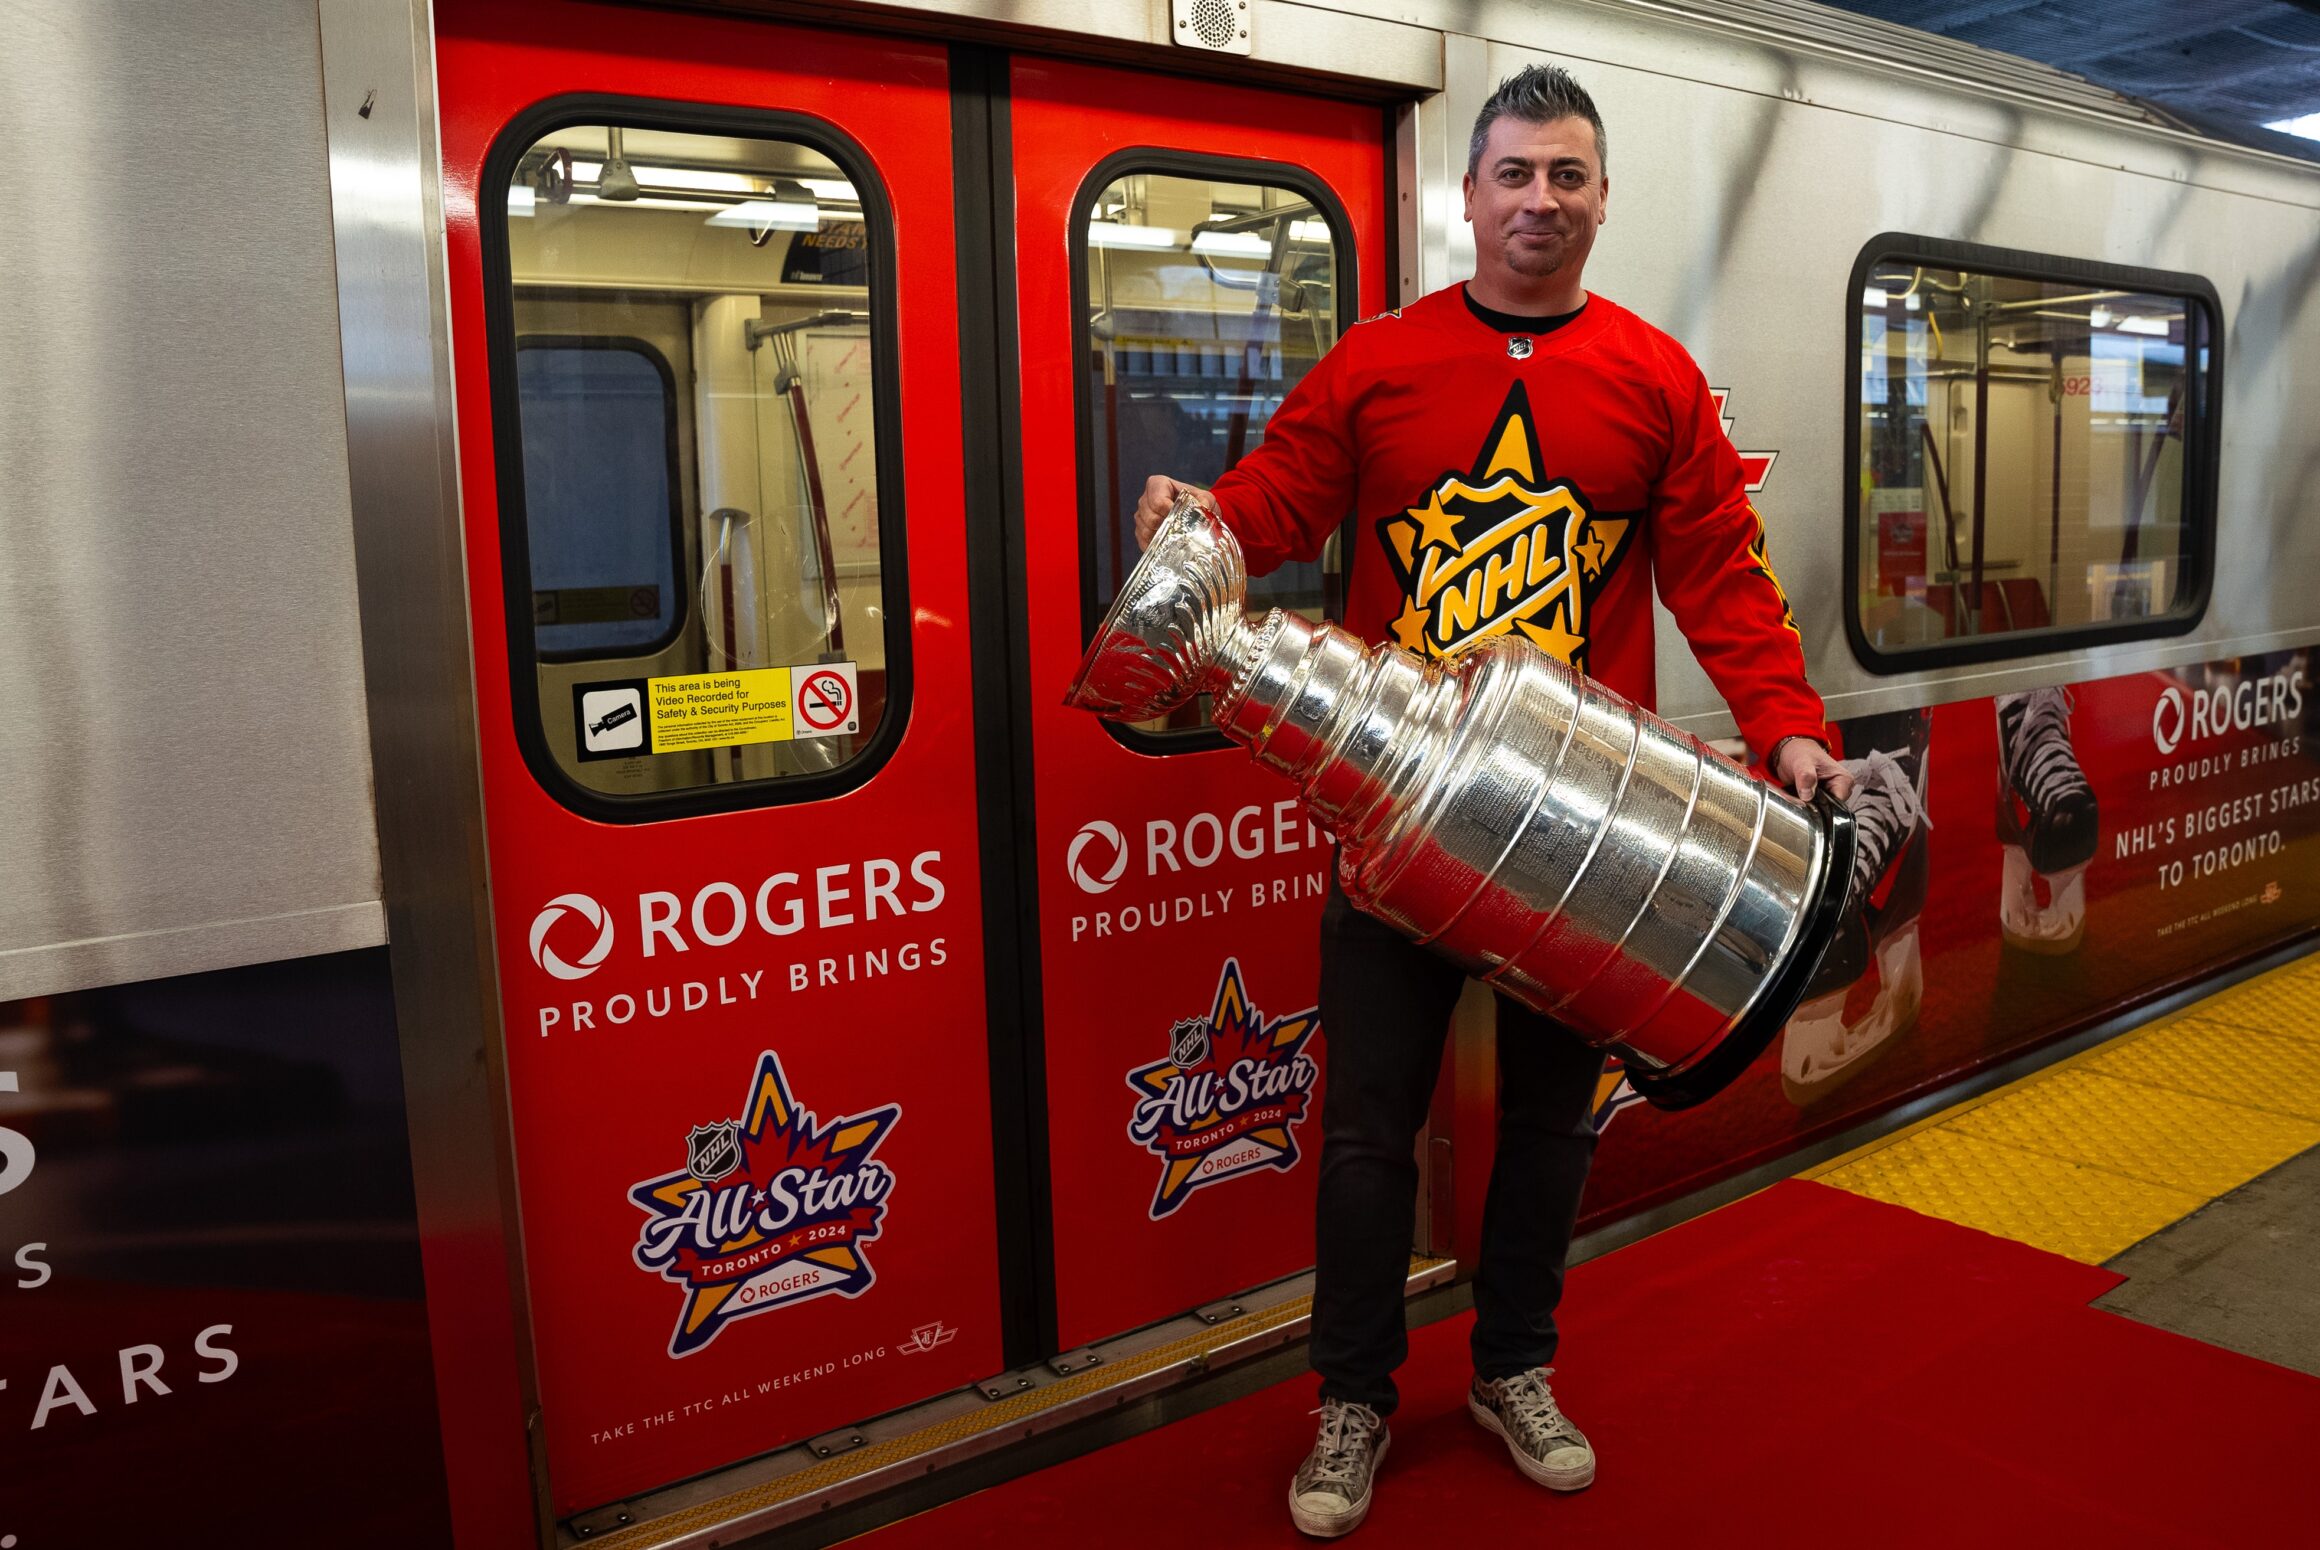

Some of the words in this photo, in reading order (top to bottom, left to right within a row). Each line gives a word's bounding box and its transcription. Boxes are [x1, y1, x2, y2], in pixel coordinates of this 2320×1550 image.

[802, 233, 859, 250] NEEDS
[1437, 523, 1563, 642] NHL
[655, 684, 676, 694] This
[678, 682, 700, 692] area
[703, 680, 711, 689] is
[713, 678, 741, 688] being
[655, 696, 684, 706] Video
[687, 691, 734, 704] Recorded
[736, 690, 749, 699] for
[657, 708, 688, 720] Safety
[690, 706, 697, 716] &
[700, 703, 739, 715] Security
[742, 700, 787, 712] Purposes
[2191, 671, 2303, 741] ROGERS
[607, 709, 631, 725] Camera
[2150, 752, 2232, 791] PROUDLY
[2240, 736, 2300, 768] BRINGS
[2116, 817, 2176, 859] NHL'S
[2185, 793, 2263, 838] BIGGEST
[2270, 777, 2320, 813] STARS
[2158, 860, 2183, 890] TO
[2192, 830, 2286, 879] TORONTO.
[638, 850, 945, 958] ROGERS
[1072, 888, 1234, 943] PROUDLY
[1252, 871, 1324, 908] BRIN
[539, 969, 764, 1038] PROUDLY
[789, 938, 947, 992] BRINGS
[1178, 1029, 1202, 1060] NHL
[1136, 1071, 1213, 1134] All
[1220, 1058, 1312, 1113] Star
[699, 1136, 731, 1170] NHL
[1175, 1124, 1234, 1151] TORONTO
[1254, 1109, 1282, 1123] 2024
[1216, 1147, 1261, 1170] ROGERS
[643, 1184, 753, 1259] All
[759, 1165, 886, 1231] Star
[15, 1243, 52, 1288] S
[701, 1243, 782, 1276] TORONTO
[808, 1224, 847, 1242] 2024
[759, 1270, 821, 1297] ROGERS
[0, 1324, 239, 1430] ARS
[590, 1423, 635, 1445] TAKE
[642, 1411, 676, 1428] THE
[683, 1399, 714, 1417] TTC
[721, 1388, 751, 1406] ALL
[757, 1362, 836, 1395] WEEKEND
[843, 1346, 887, 1369] LONG
